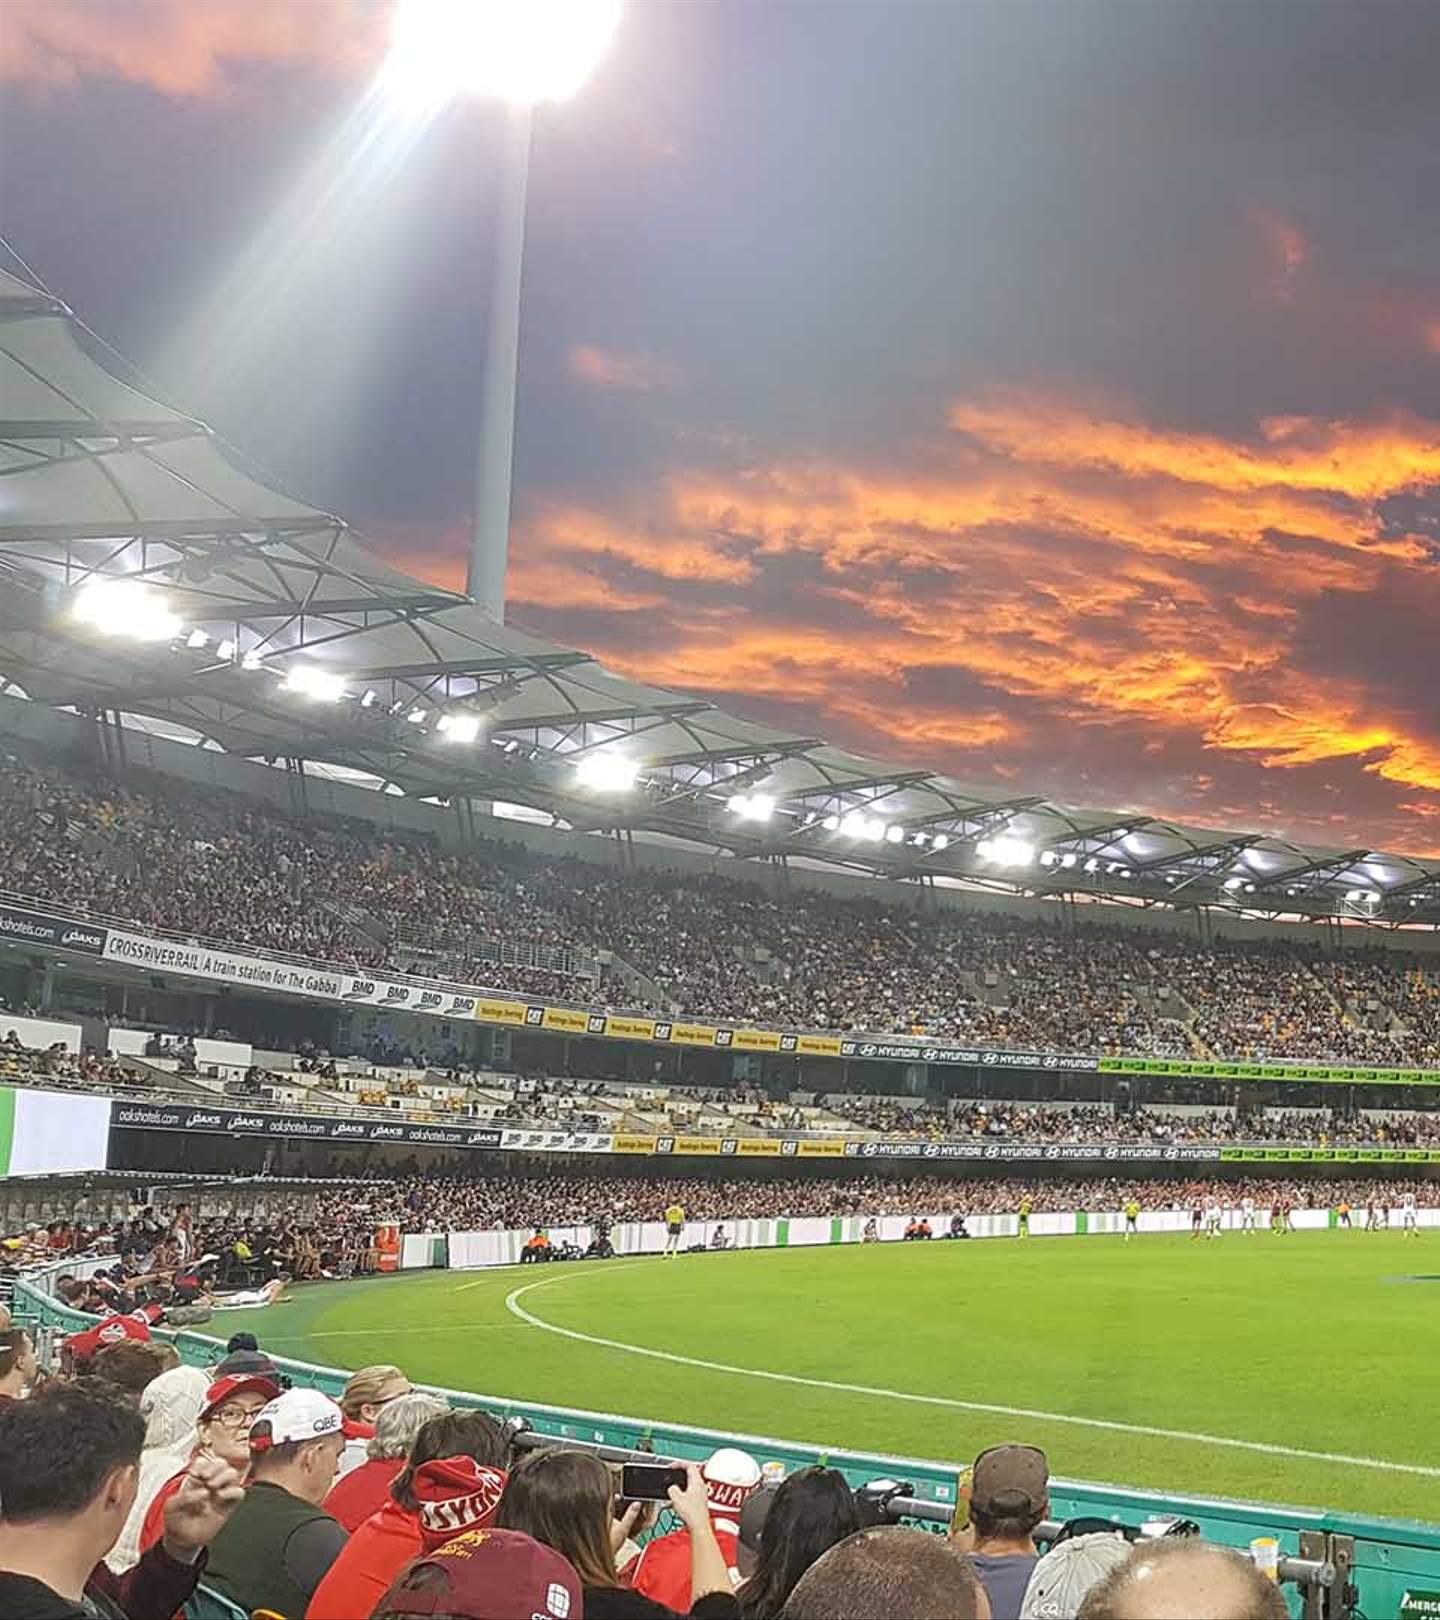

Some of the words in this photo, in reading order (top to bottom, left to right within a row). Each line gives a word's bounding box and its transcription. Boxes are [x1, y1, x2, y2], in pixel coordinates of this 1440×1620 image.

[110, 937, 198, 970] CROSSRIVERRAIL
[203, 957, 211, 972] A
[213, 960, 236, 975] train
[238, 966, 271, 981] station
[273, 970, 286, 985] for
[289, 973, 304, 988] The
[306, 976, 337, 994] Gabba
[352, 981, 375, 995] BMD
[387, 986, 409, 1000] BMD
[421, 992, 442, 1006] BMD
[453, 997, 475, 1010] BMD
[878, 1046, 919, 1058] HYUNDAI
[939, 1050, 979, 1062] HYUNDAI
[1000, 1055, 1040, 1066] HYUNDAI
[1060, 1059, 1097, 1069] HYUNDAI
[119, 1108, 180, 1125] oakshotels.com
[878, 1145, 920, 1155] HYUNDAI
[940, 1146, 982, 1156] HYUNDAI
[1001, 1147, 1041, 1157] HYUNDAI
[1062, 1148, 1100, 1157] HYUNDAI
[1120, 1148, 1161, 1157] HYUNDAI
[1181, 1148, 1219, 1158] HYUNDAI
[313, 1415, 337, 1432] QBE
[707, 1481, 749, 1506] SWA
